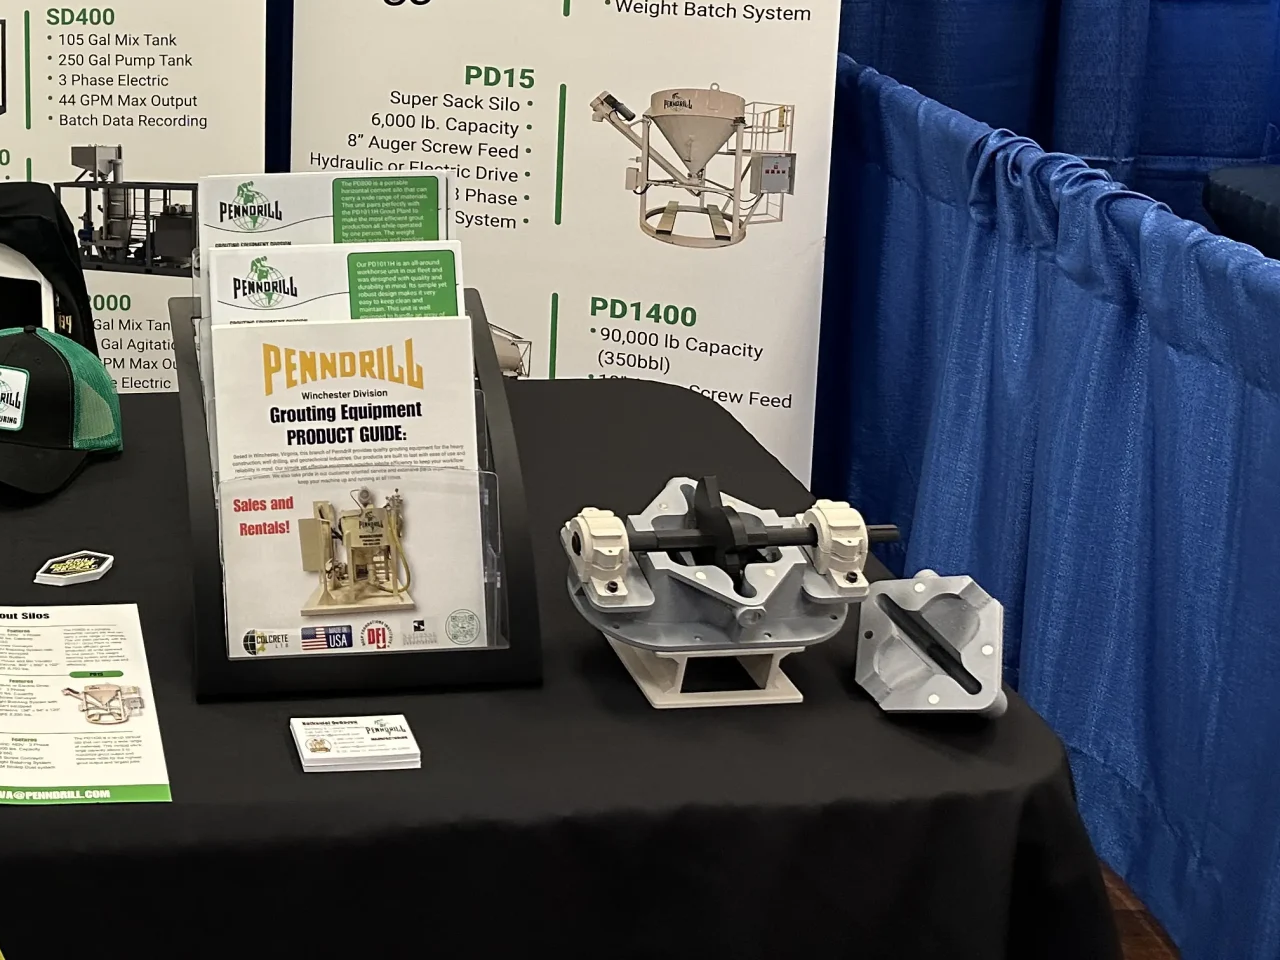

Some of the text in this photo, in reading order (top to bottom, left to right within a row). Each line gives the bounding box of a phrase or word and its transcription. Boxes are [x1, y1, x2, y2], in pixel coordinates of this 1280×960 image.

[46, 7, 115, 26] SD400
[684, 1, 737, 19] Batch
[742, 4, 811, 24] System
[464, 65, 535, 89] PD15
[58, 94, 198, 110] 44 GPM Max Output
[390, 90, 520, 112] Super Sack Silo
[219, 200, 283, 223] PENNDRILL
[233, 276, 298, 300] PENNDRILL
[590, 296, 697, 328] PD1400
[261, 337, 424, 397] PENNDRILL
[301, 389, 388, 400] Winchester Division
[270, 401, 422, 424] Grouting Equipment
[286, 424, 407, 446] PRODUCT GUIDE:
[233, 495, 294, 513] Sales and
[239, 521, 290, 536] Rentals!
[21, 612, 50, 620] Silos
[329, 635, 347, 648] USA
[367, 628, 386, 647] DFI
